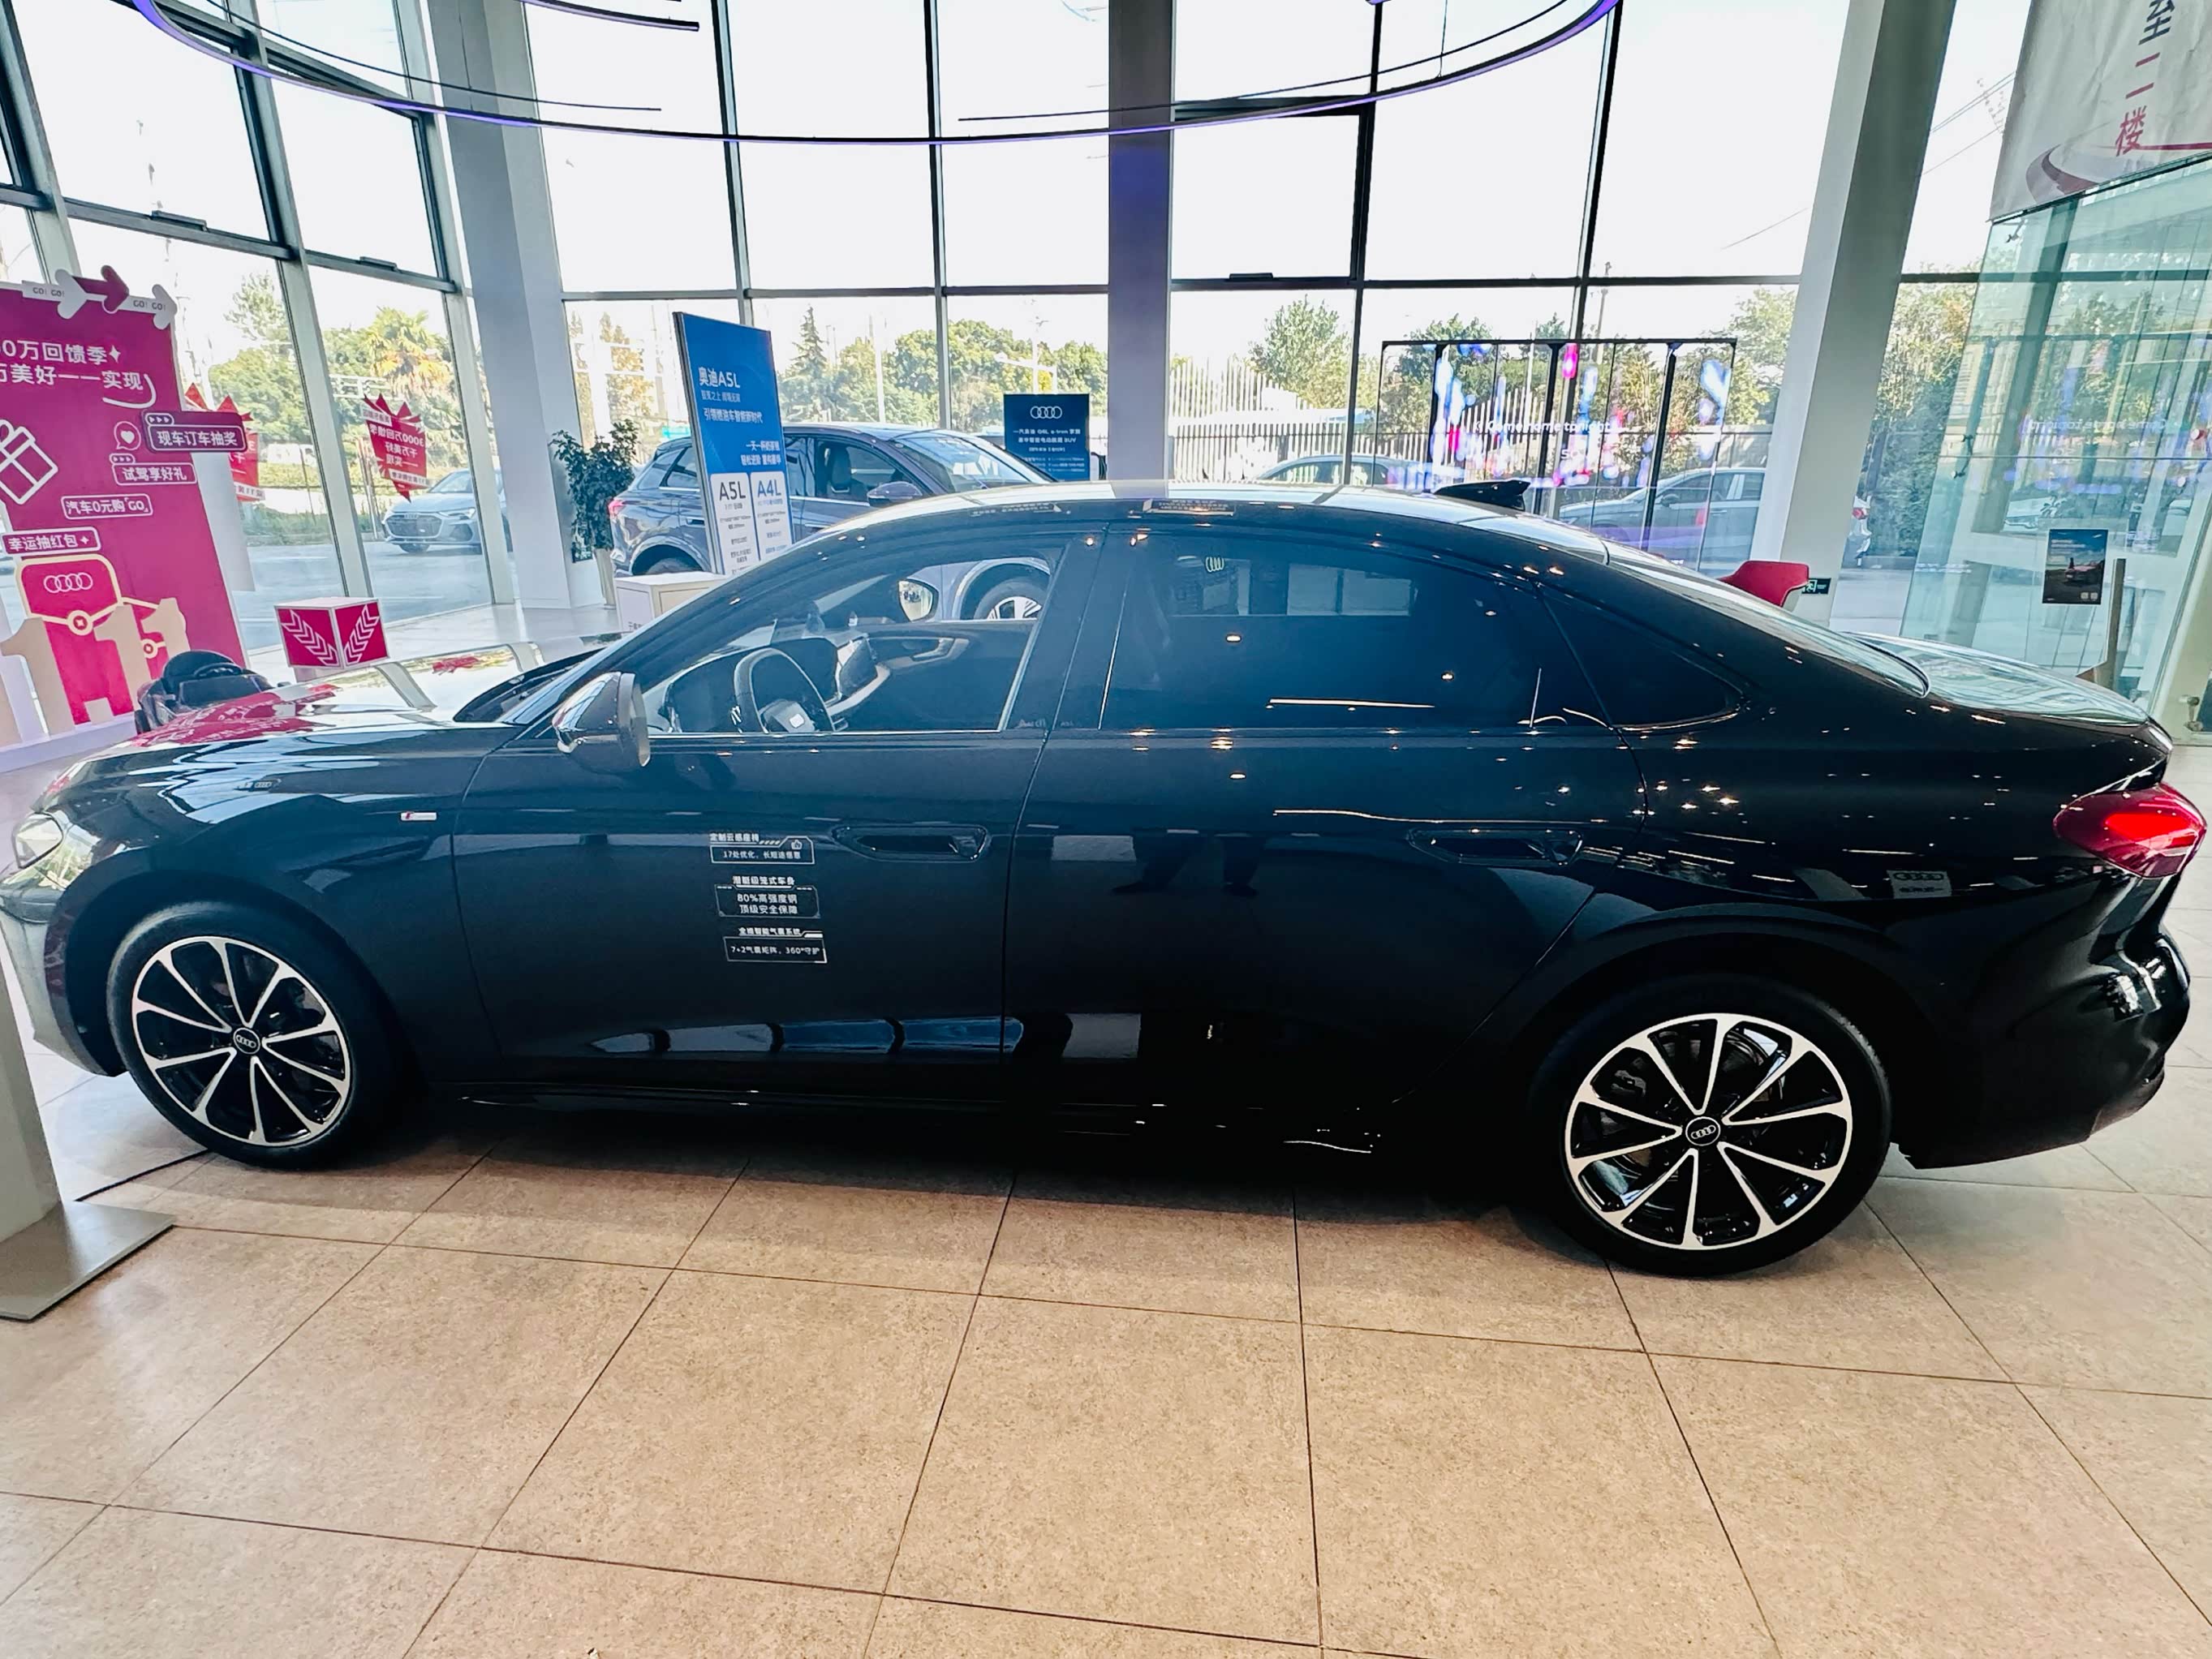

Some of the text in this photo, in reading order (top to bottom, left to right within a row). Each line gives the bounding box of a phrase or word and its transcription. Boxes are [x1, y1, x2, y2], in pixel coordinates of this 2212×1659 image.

[0, 339, 107, 365] 0万回馈季
[698, 366, 741, 389] 奥迪A5L
[157, 430, 238, 447] 现车订车抽奖
[122, 466, 187, 482] 试驾享好礼
[719, 480, 747, 501] A5L
[757, 479, 782, 498] A4L
[8, 533, 79, 552] 幸运抽红包
[737, 893, 798, 905] 80%高强度钢
[739, 904, 798, 915] 顶级安全保障
